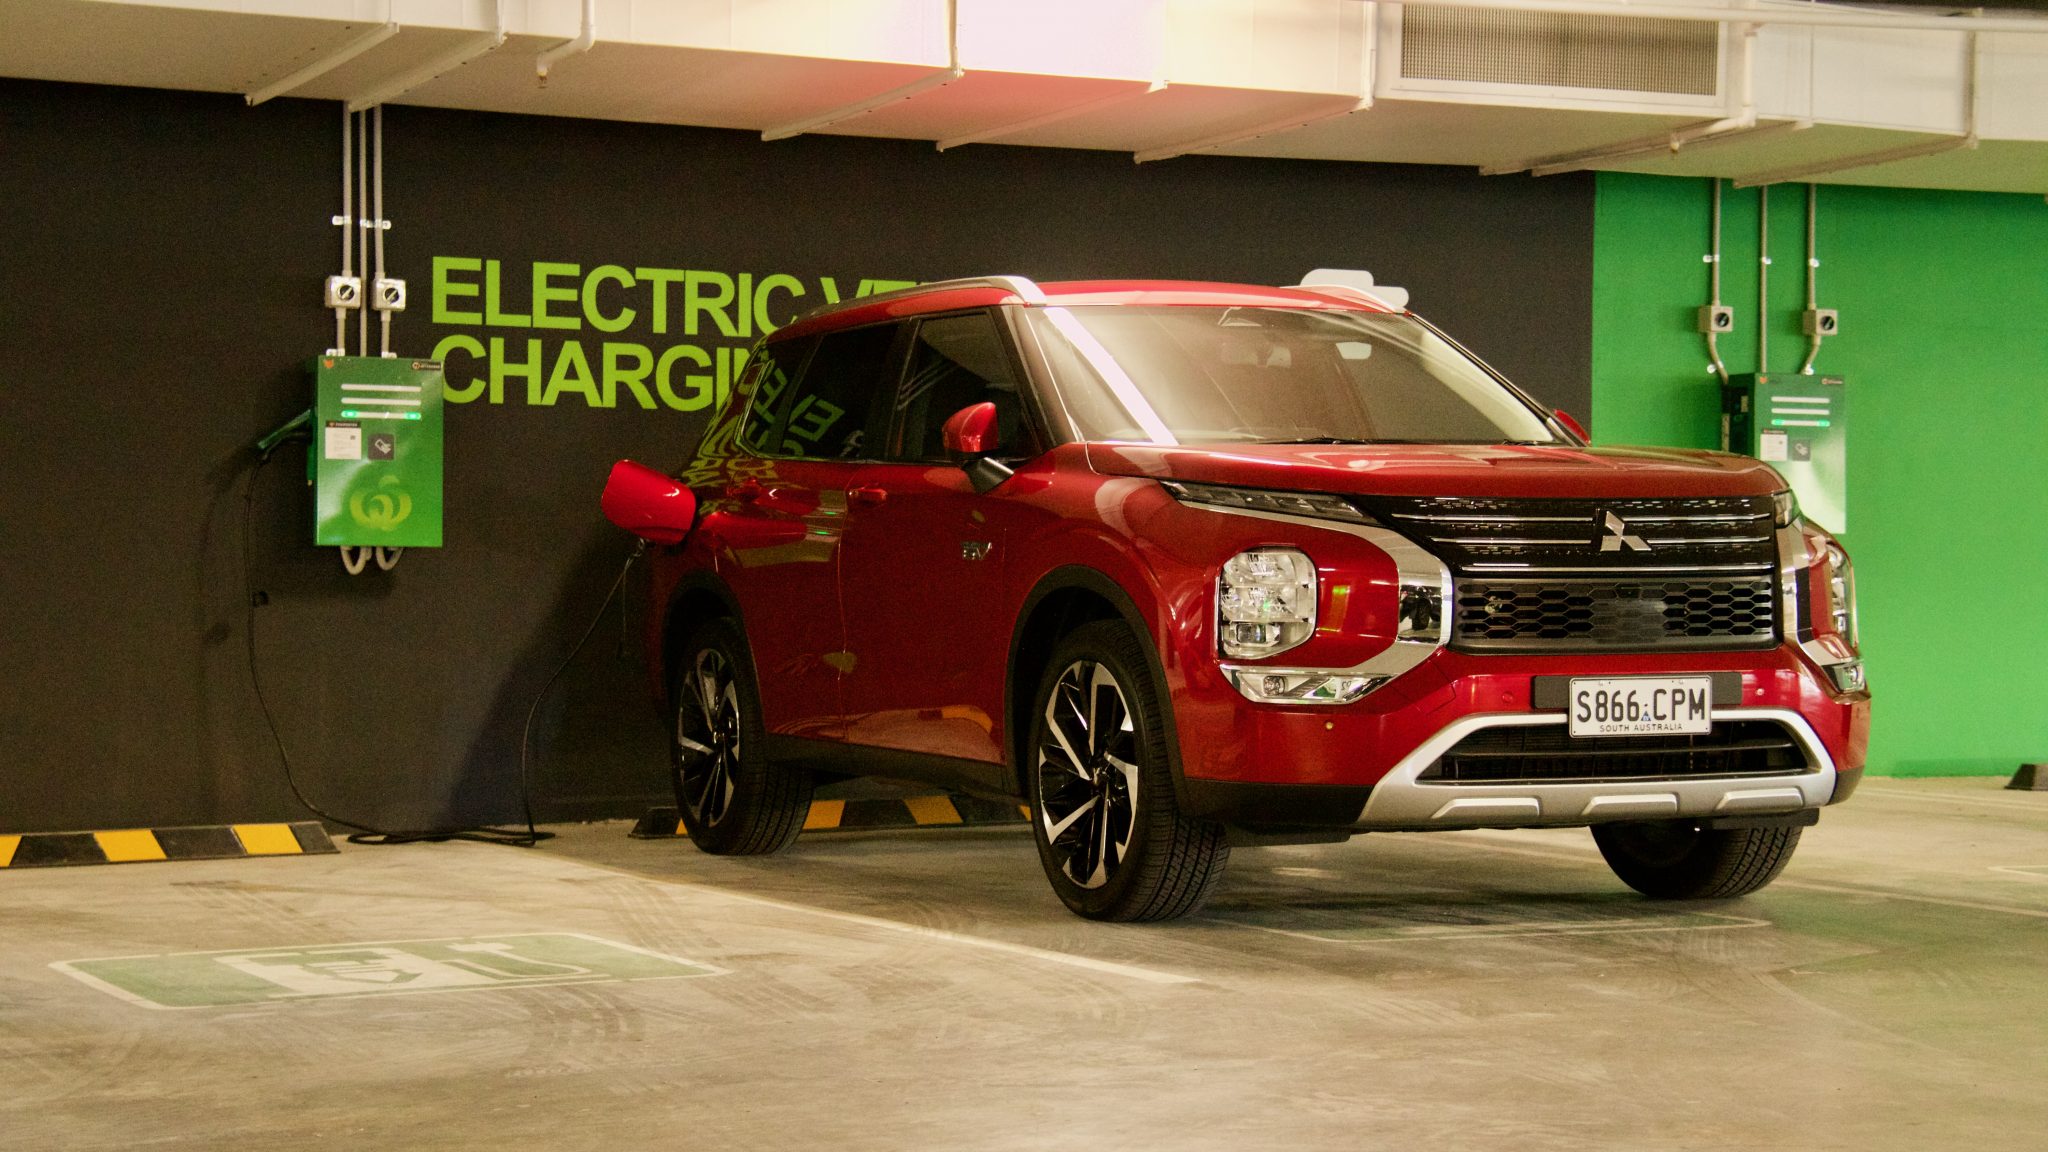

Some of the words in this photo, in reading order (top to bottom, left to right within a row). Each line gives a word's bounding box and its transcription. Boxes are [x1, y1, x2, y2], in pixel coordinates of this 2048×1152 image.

[432, 256, 806, 337] ELECTRIC
[1599, 724, 1630, 732] SOUTH
[1633, 723, 1683, 731] AUSTRALIA
